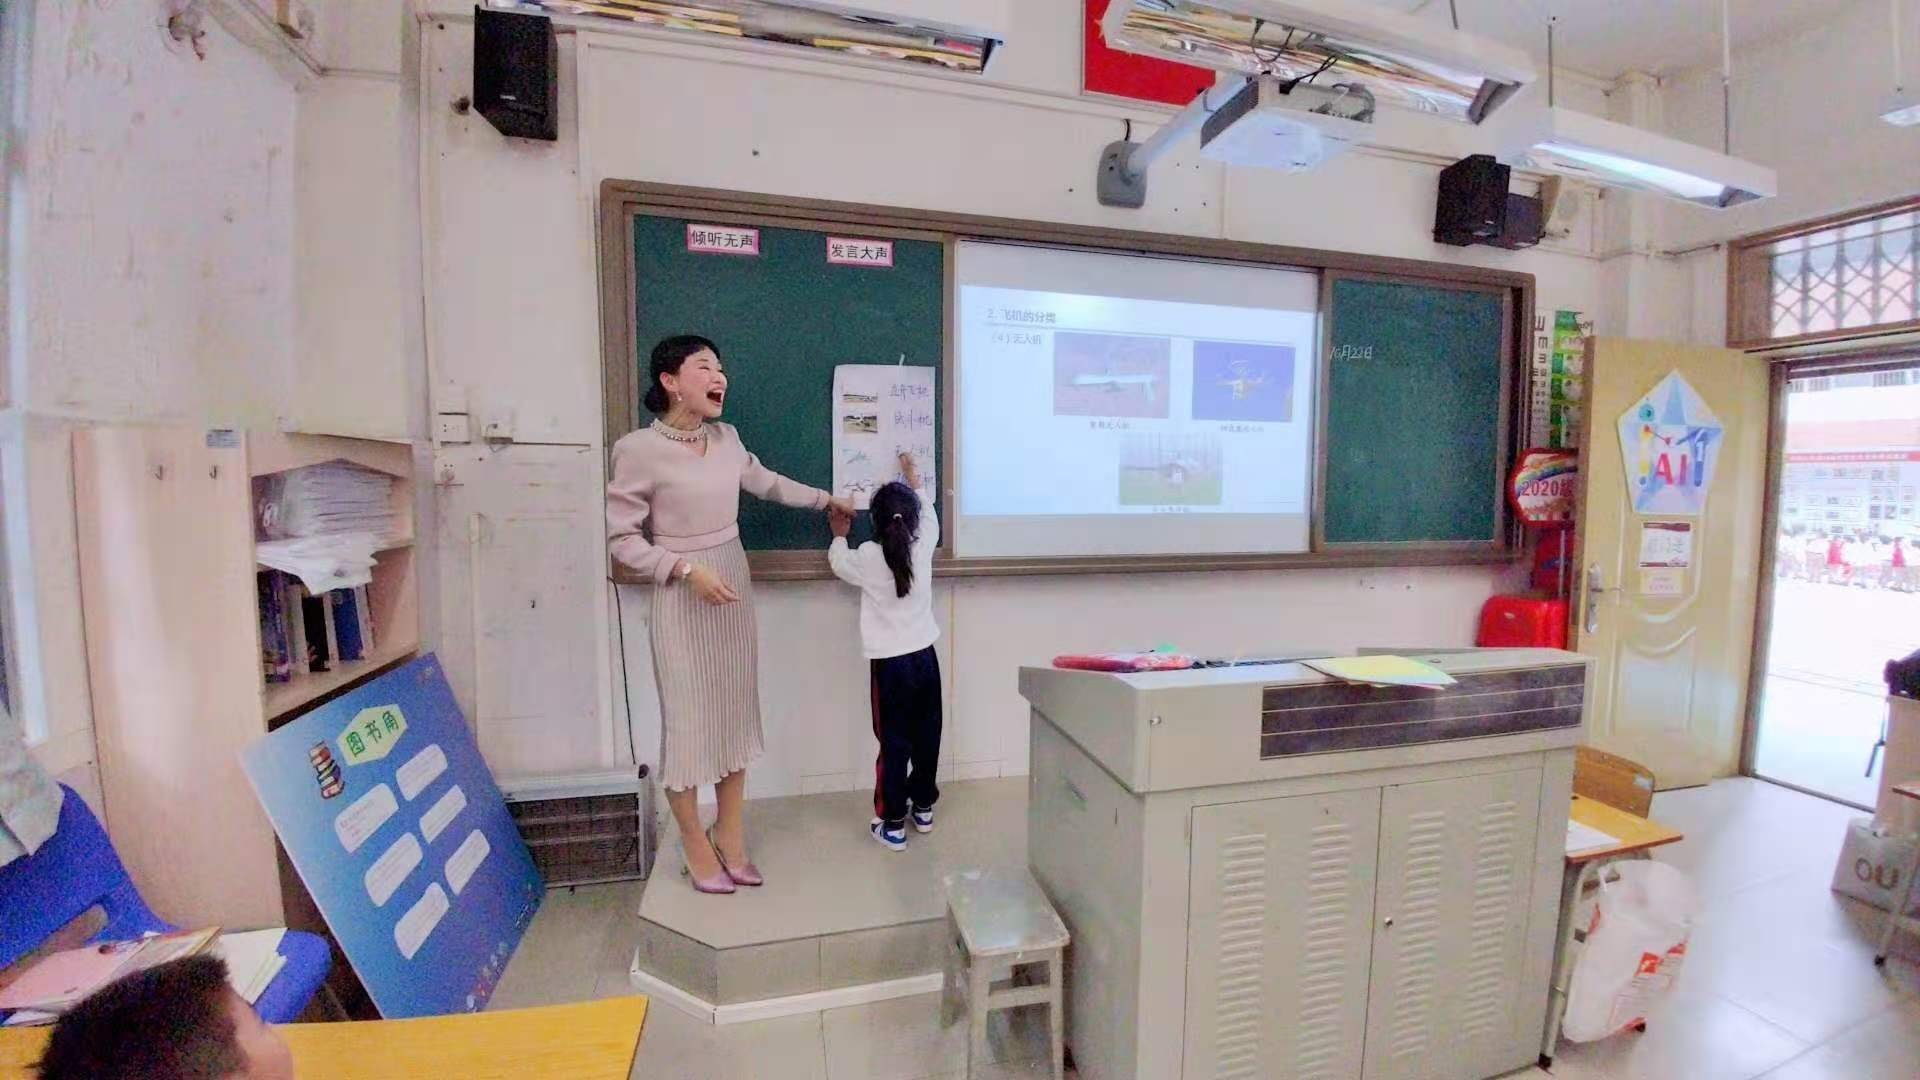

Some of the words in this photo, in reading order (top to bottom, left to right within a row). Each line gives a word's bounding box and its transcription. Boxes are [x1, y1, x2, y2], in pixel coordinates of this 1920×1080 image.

[691, 229, 753, 248] 倾听无声
[831, 243, 888, 260] 发言大声
[345, 709, 400, 758] 图书角
